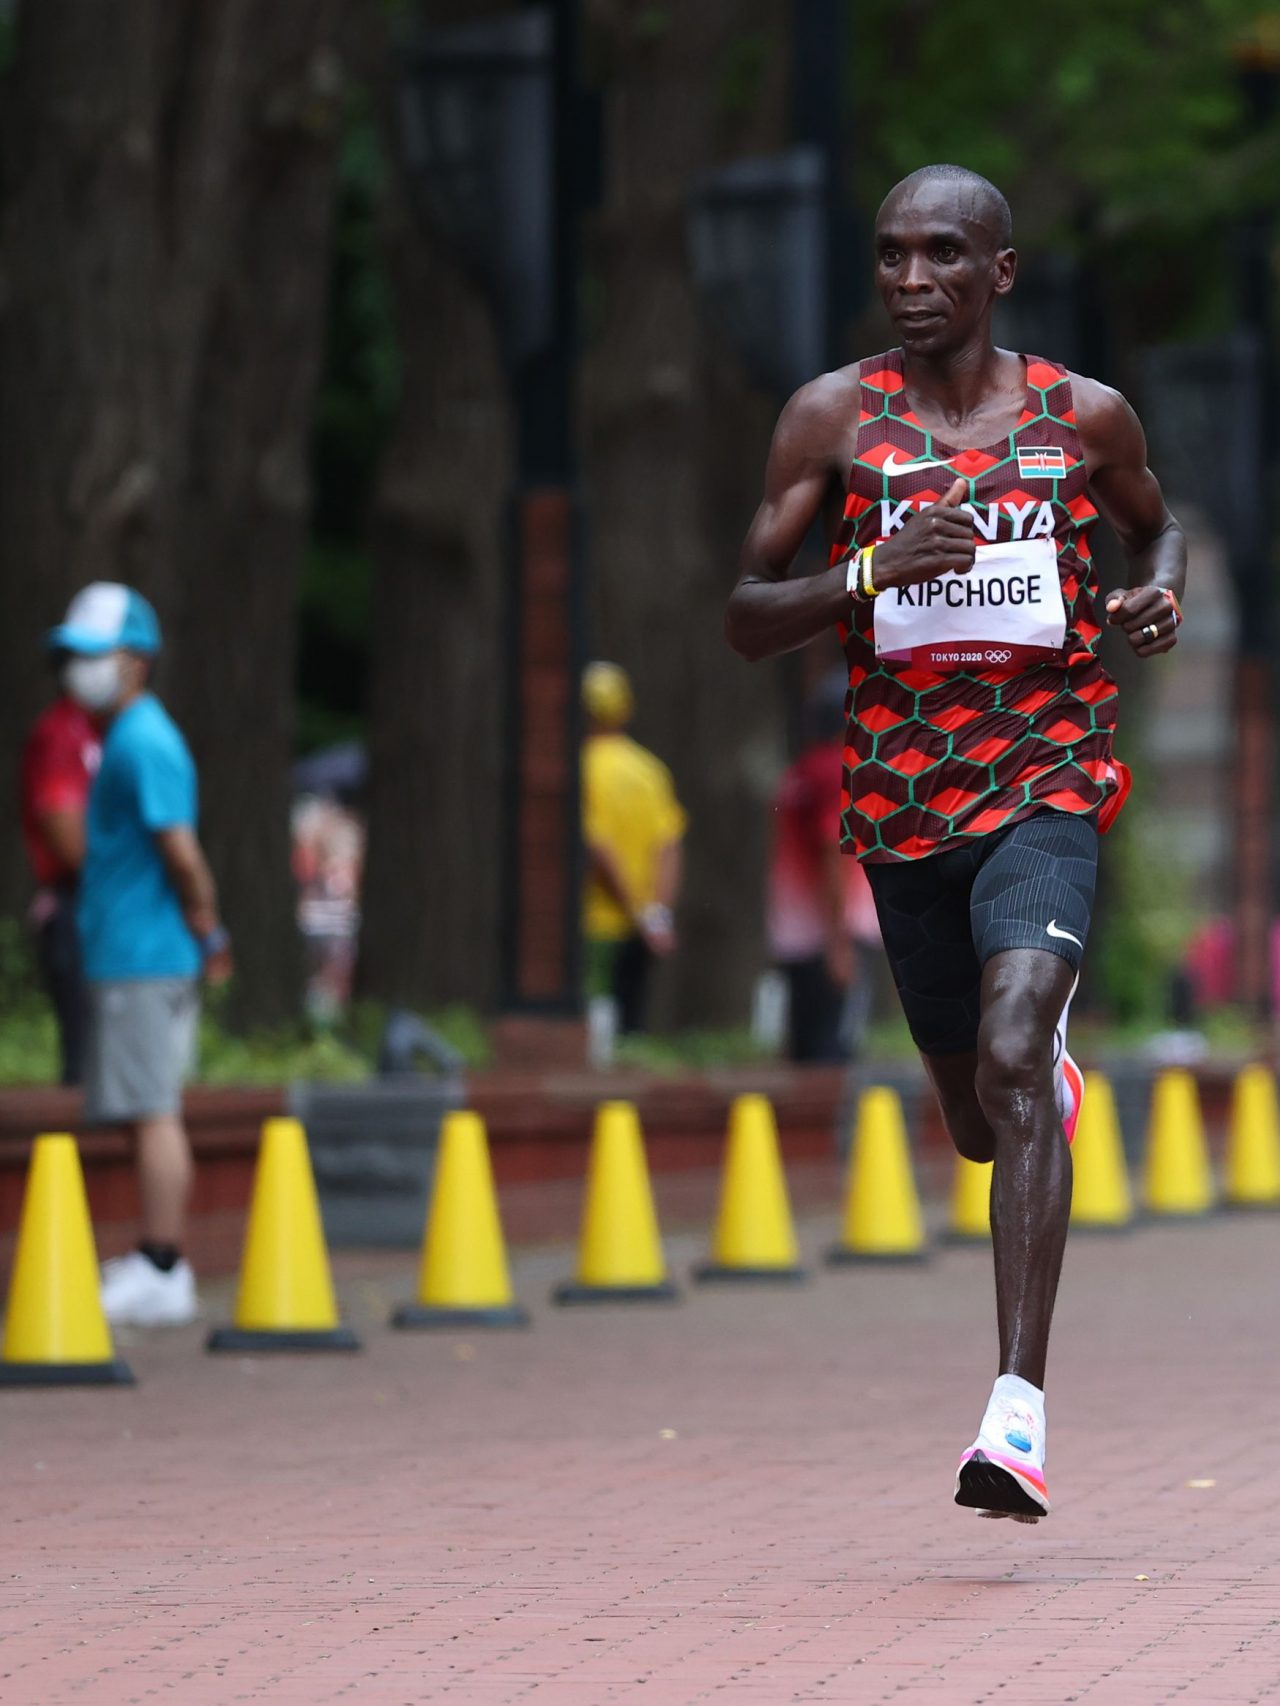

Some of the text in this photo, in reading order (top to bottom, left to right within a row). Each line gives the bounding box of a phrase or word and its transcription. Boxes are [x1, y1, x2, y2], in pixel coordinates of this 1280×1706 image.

[881, 500, 1055, 541] KNYA
[897, 575, 1041, 607] KIPCHOGE
[931, 652, 982, 662] TOKYO 2020
